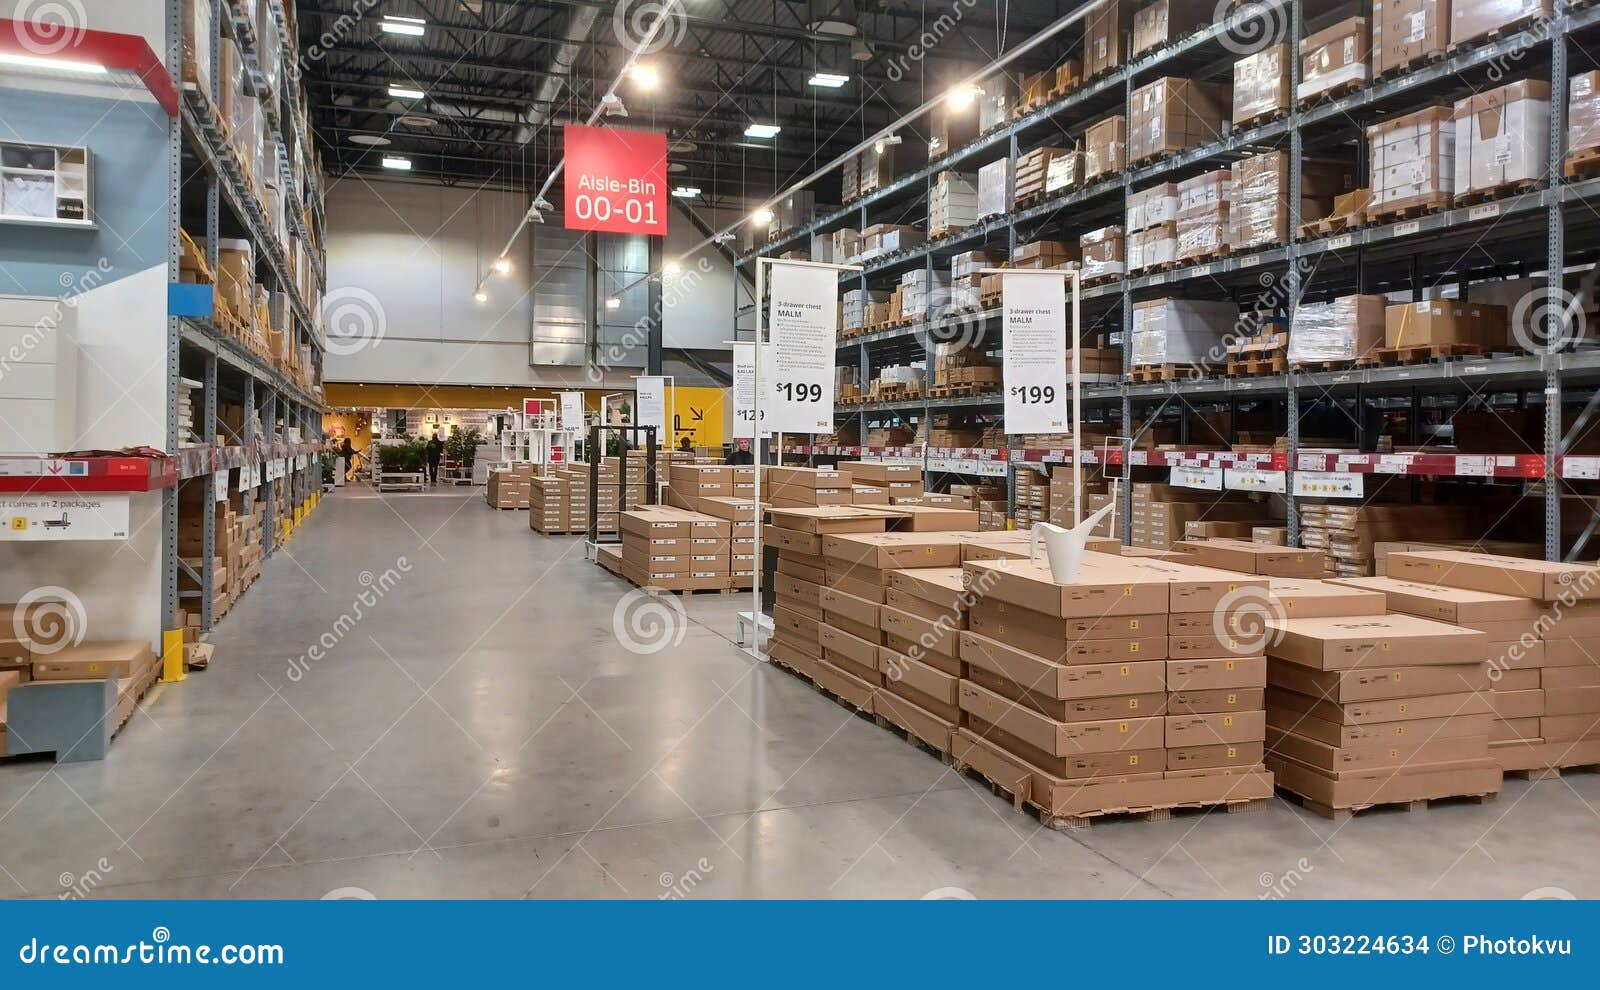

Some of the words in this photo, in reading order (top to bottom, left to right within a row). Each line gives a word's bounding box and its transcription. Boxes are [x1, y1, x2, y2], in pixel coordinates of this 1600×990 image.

[578, 174, 656, 196] Aisle-Bin
[575, 194, 658, 225] 00-01
[777, 310, 802, 318] MALM
[776, 382, 822, 402] $199
[1011, 385, 1055, 404] $199
[41, 500, 49, 508] in
[52, 500, 58, 508] 2
[60, 500, 101, 509] packages
